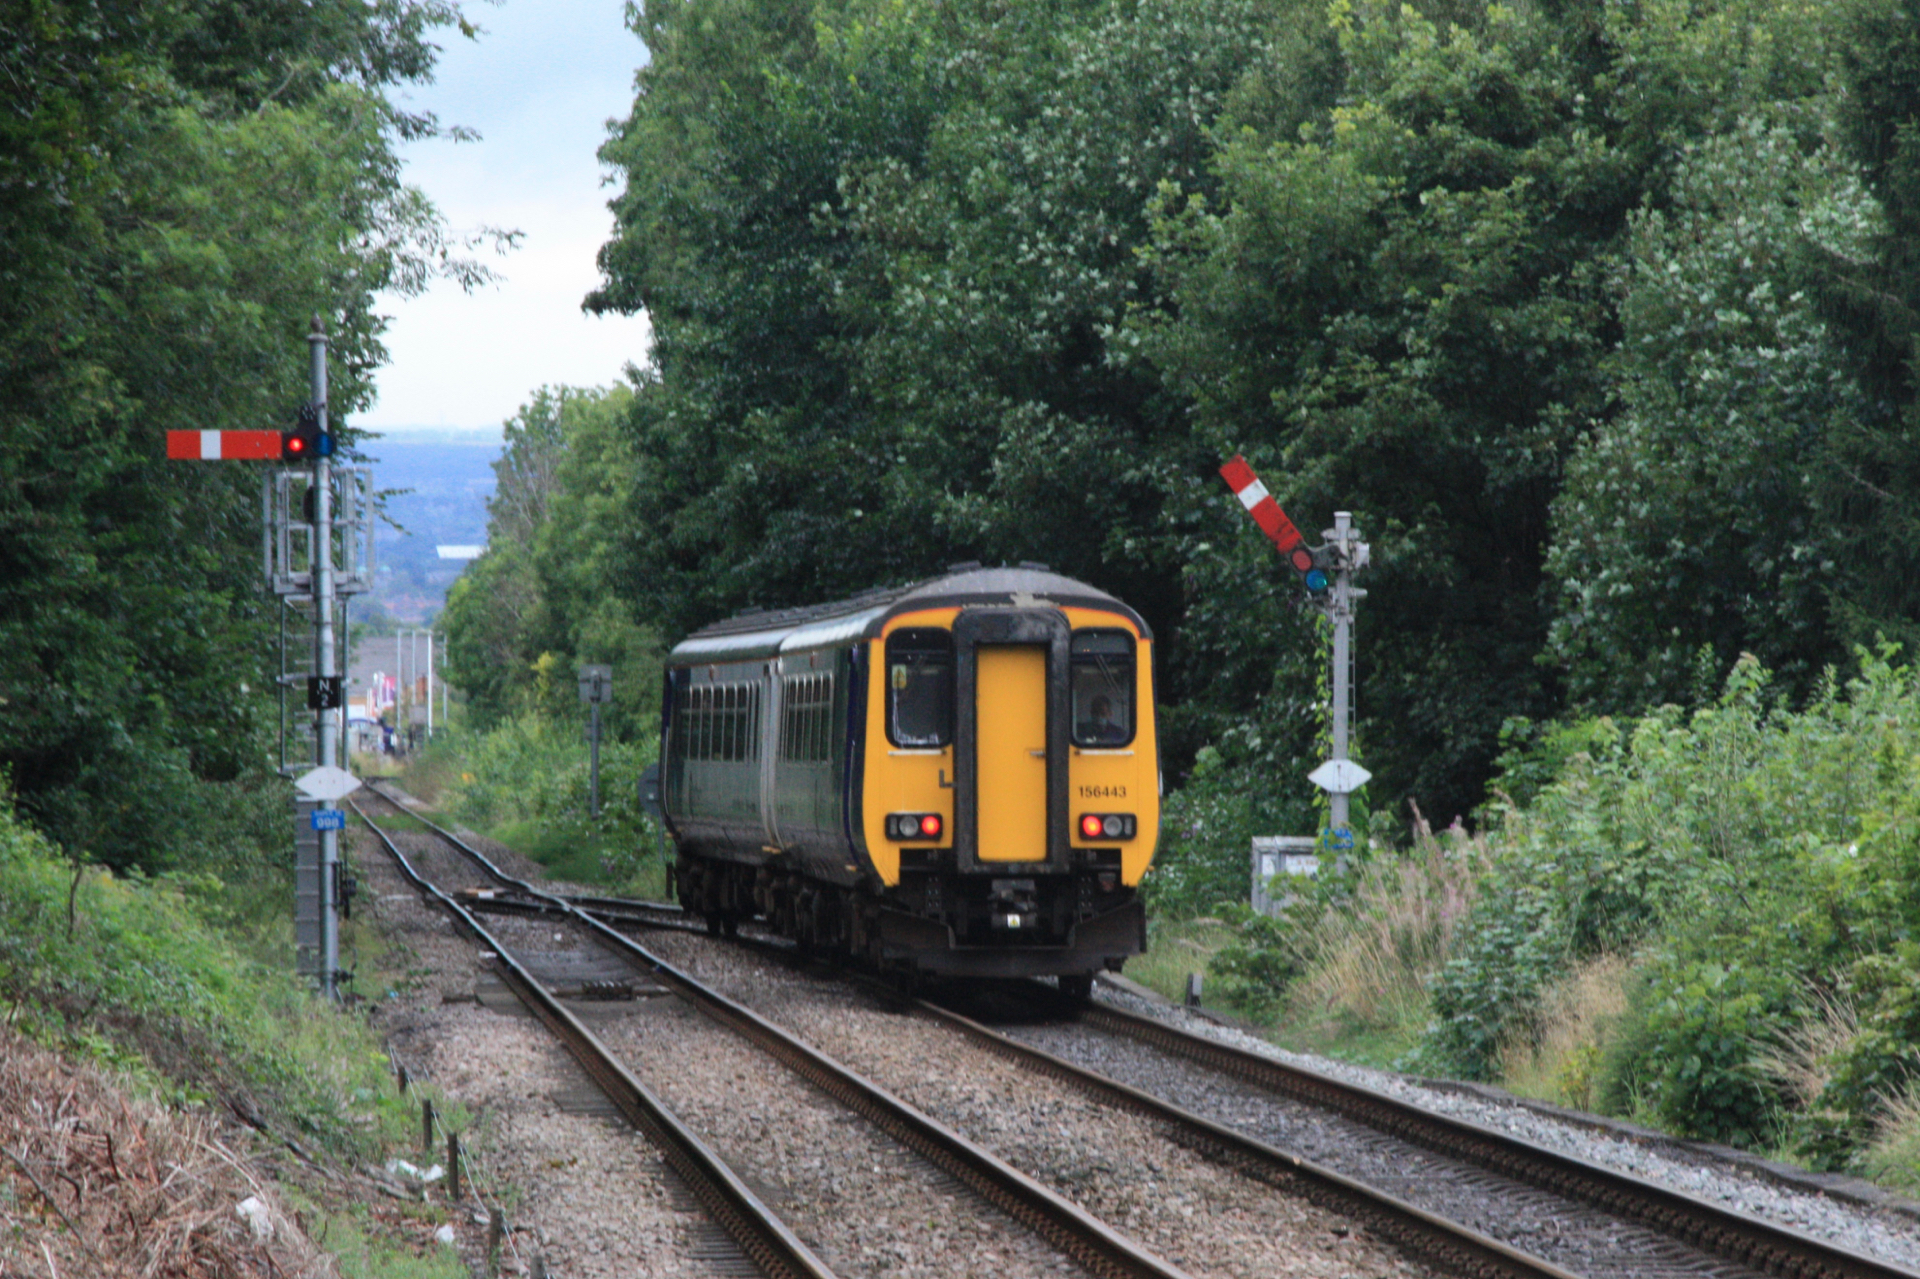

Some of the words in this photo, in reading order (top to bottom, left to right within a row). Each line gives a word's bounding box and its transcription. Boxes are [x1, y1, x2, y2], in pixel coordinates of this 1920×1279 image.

[319, 679, 330, 691] N
[321, 693, 329, 707] 2
[1079, 785, 1126, 798] 156443
